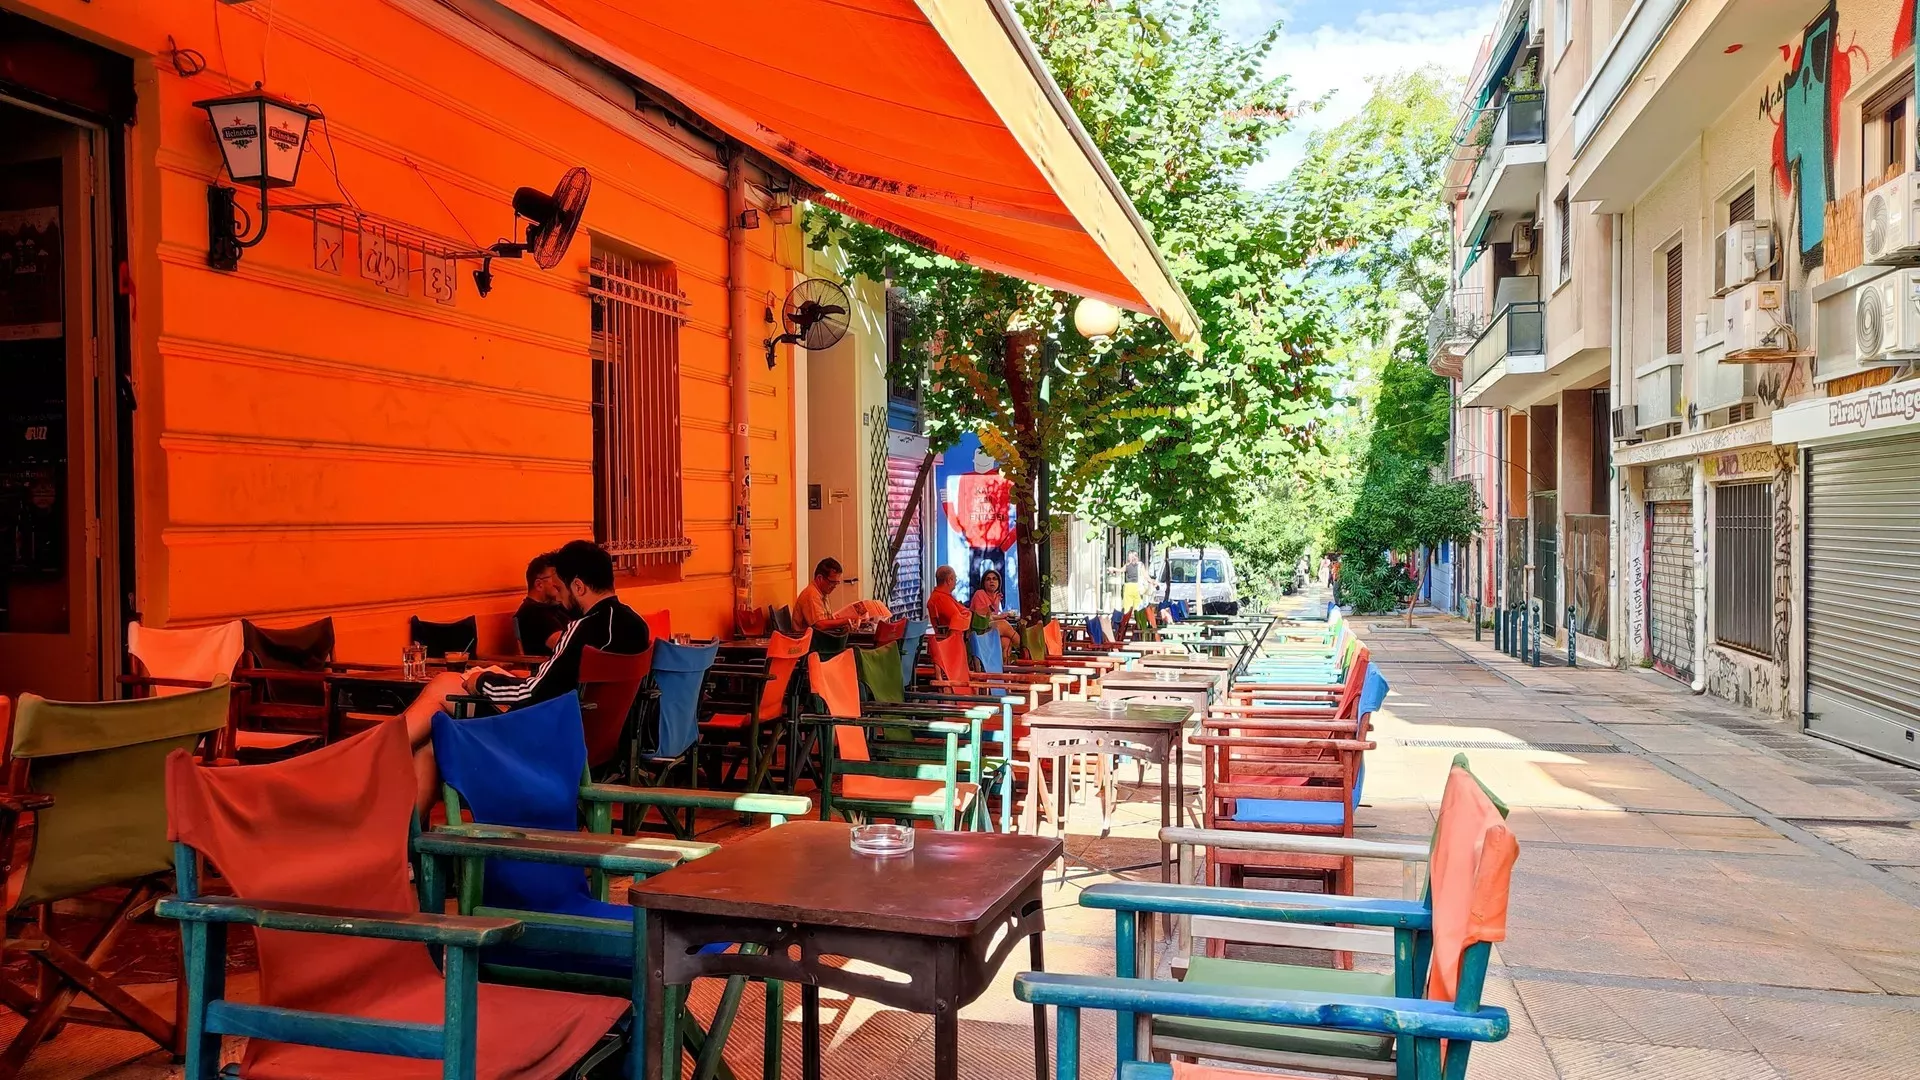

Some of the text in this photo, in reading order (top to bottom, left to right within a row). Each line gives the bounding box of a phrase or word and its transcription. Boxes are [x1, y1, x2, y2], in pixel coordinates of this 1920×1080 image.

[225, 128, 255, 138] Heineken
[271, 128, 297, 143] Heineken
[1829, 389, 1920, 428] Piracy Vintage
